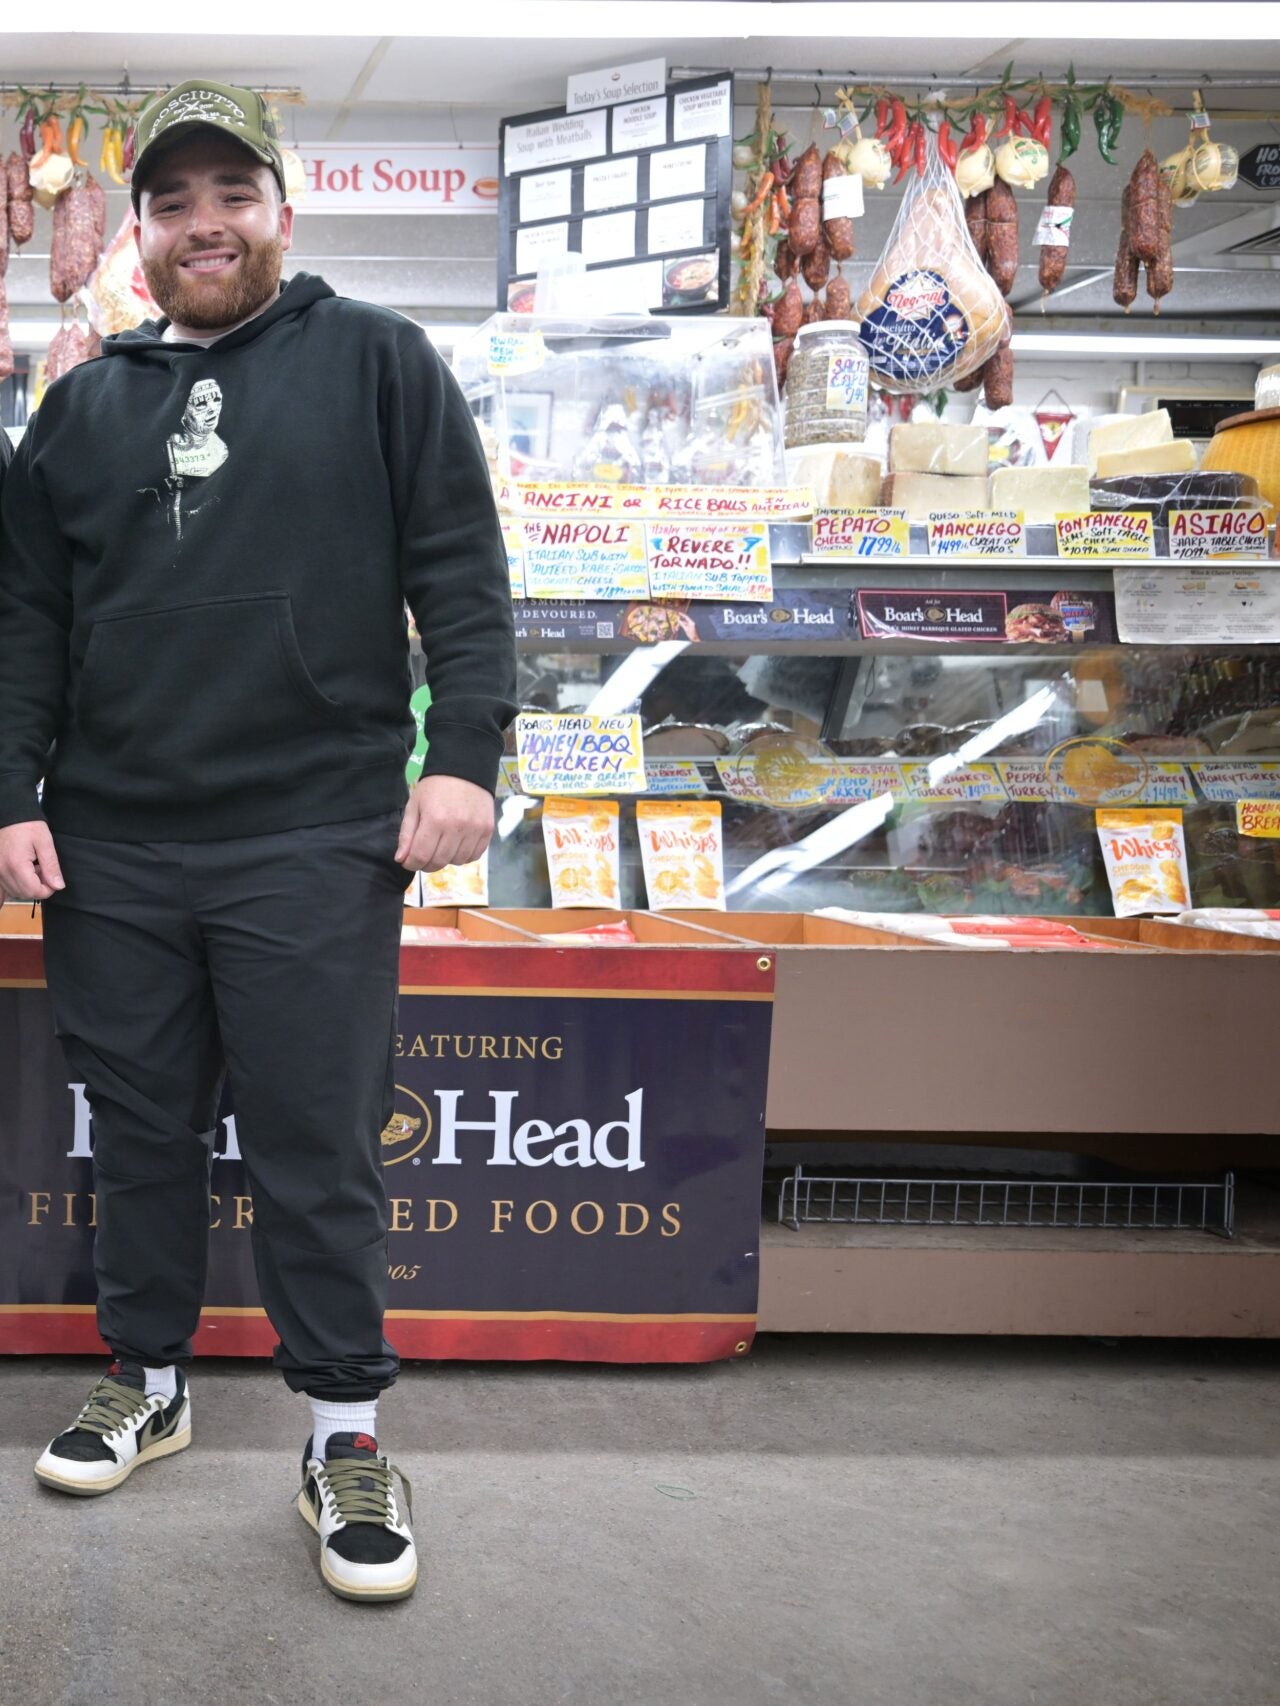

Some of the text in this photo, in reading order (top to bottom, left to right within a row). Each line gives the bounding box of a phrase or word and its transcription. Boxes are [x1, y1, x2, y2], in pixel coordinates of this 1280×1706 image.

[573, 80, 660, 105] Today's Soup Selection
[644, 111, 657, 121] SOUP
[526, 118, 584, 138] Italian Wedding
[516, 130, 592, 154] Soup with Meatballs
[302, 159, 466, 202] Hot Soup
[887, 288, 946, 309] Negroni
[622, 498, 643, 508] OR
[658, 497, 703, 511] RICE
[706, 498, 748, 512] BALLS
[751, 501, 810, 512] AMERICAN
[929, 511, 960, 520] QUESO
[816, 516, 891, 535] PEPATO
[932, 522, 1022, 538] MANCHEGO
[1058, 513, 1149, 538] FONTANELLA
[1173, 512, 1265, 536] ASIAGO
[524, 523, 631, 545] THE NAPOLI
[814, 536, 854, 547] CHEESE
[1003, 537, 1020, 545] ON
[1117, 529, 1151, 543] TABLE
[1171, 535, 1266, 547] SHARP TABLE CHEESE
[666, 536, 735, 553] REVERE
[979, 545, 1014, 554] TACOS
[527, 549, 628, 561] ITALIAN SUB WITH
[704, 572, 728, 582] SUB
[730, 573, 768, 582] TOPPED
[723, 608, 835, 625] Boar's Head
[884, 607, 983, 623] Boar's Head
[541, 628, 566, 639] Head
[557, 718, 592, 730] HEAD
[521, 734, 634, 758] HONEY BBQ
[527, 753, 623, 772] CHICKEN
[1006, 772, 1050, 782] PEPPER
[1197, 773, 1238, 785] HONEY
[911, 788, 963, 798] TURKEY
[1008, 786, 1053, 797] TURKEY
[649, 831, 718, 853] Whisps
[1111, 838, 1182, 861] Whisps
[394, 1033, 565, 1061] EATURING
[431, 1086, 646, 1173] Head
[490, 1201, 683, 1238] FOODS
